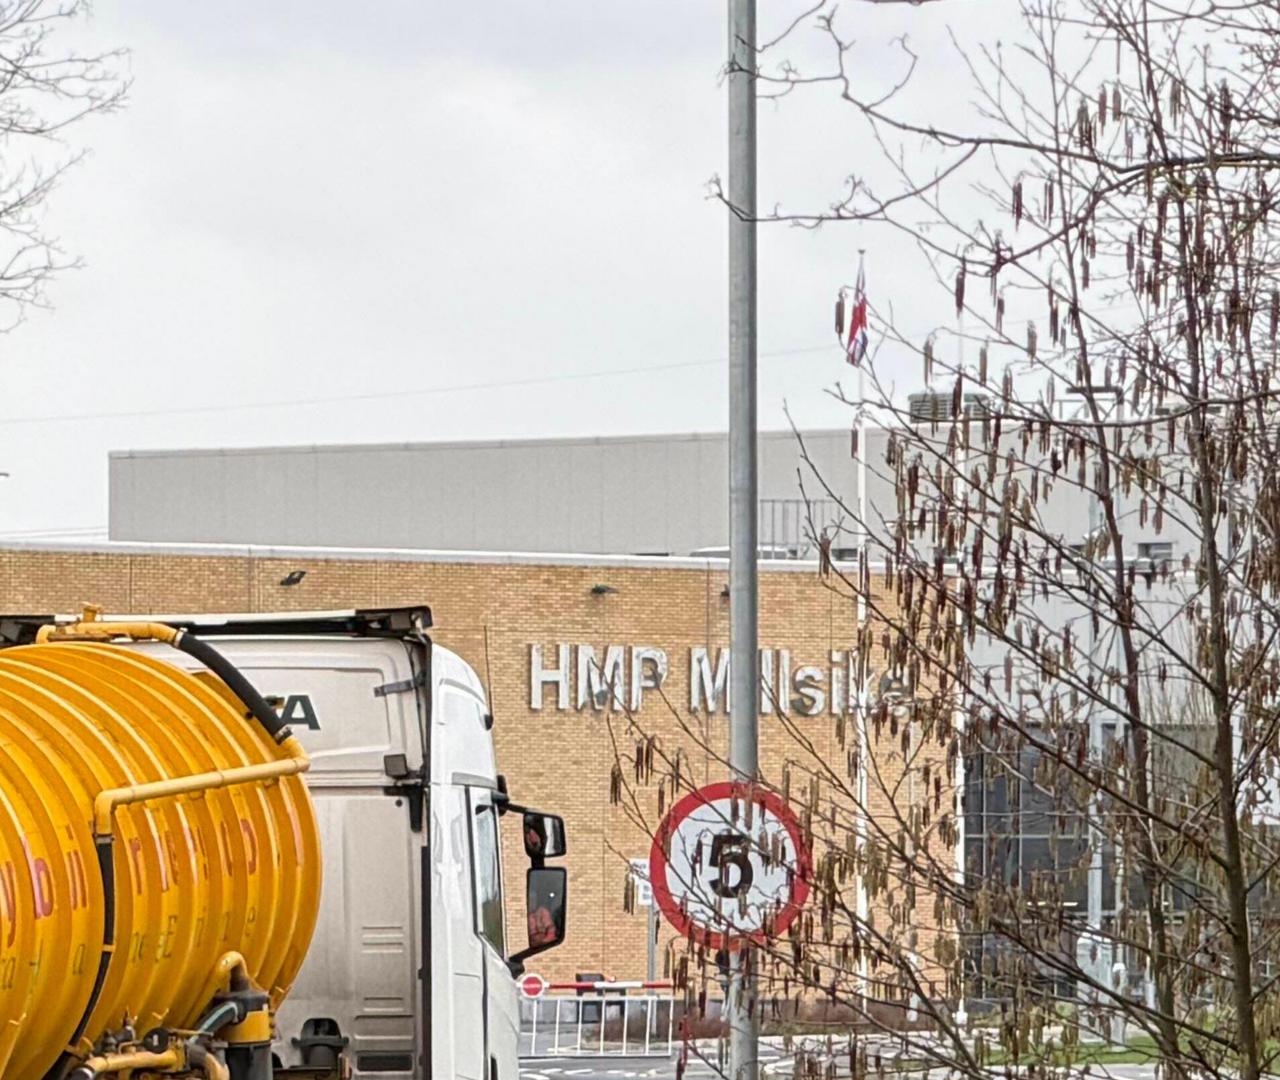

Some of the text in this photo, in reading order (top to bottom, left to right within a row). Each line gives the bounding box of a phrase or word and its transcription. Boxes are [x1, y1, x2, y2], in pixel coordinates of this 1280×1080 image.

[529, 644, 911, 717] HMP Mllsike
[709, 834, 754, 898] 5
